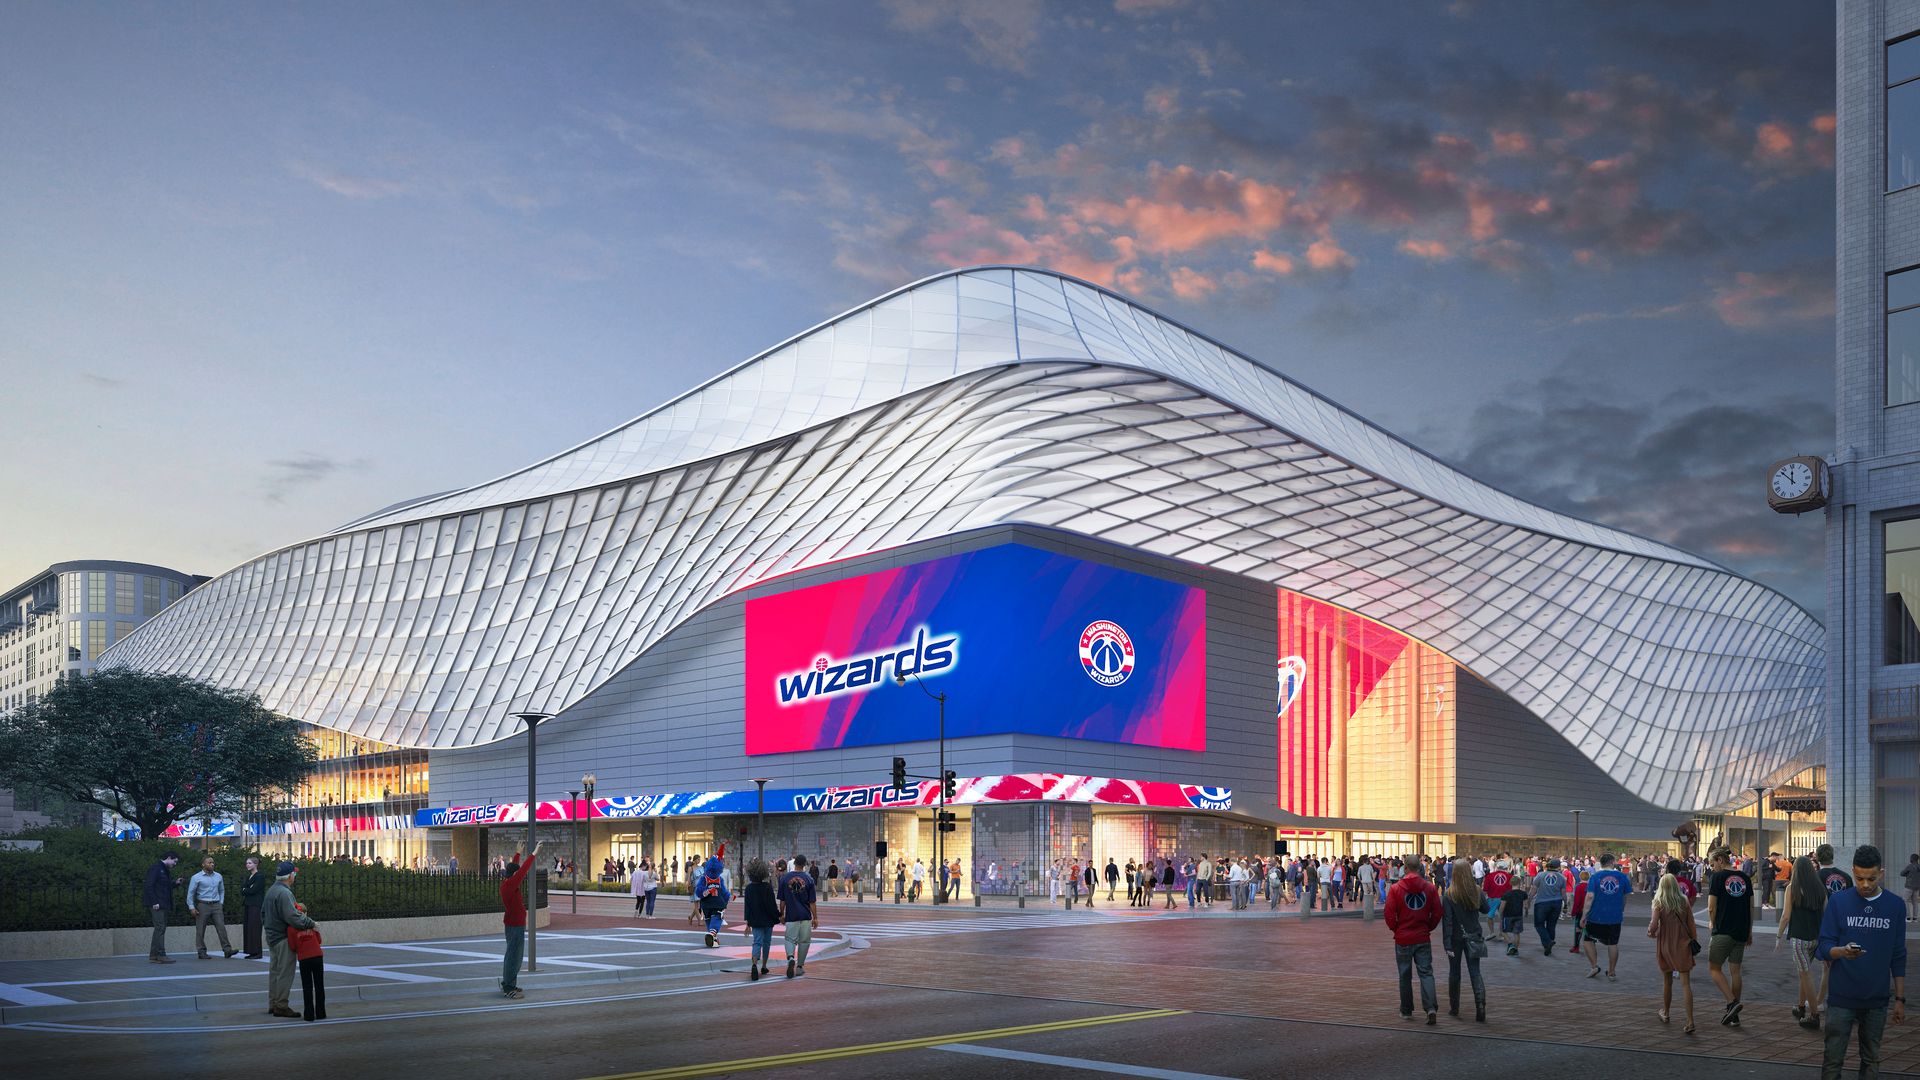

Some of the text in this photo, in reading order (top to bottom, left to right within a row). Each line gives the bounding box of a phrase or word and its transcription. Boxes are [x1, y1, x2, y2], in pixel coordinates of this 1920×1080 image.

[1085, 622, 1129, 644] WASHINGTON
[779, 628, 957, 702] wizards
[1090, 669, 1125, 684] WIZARDS
[609, 795, 653, 818] WIZARDS
[1847, 916, 1891, 930] WIZARDS
